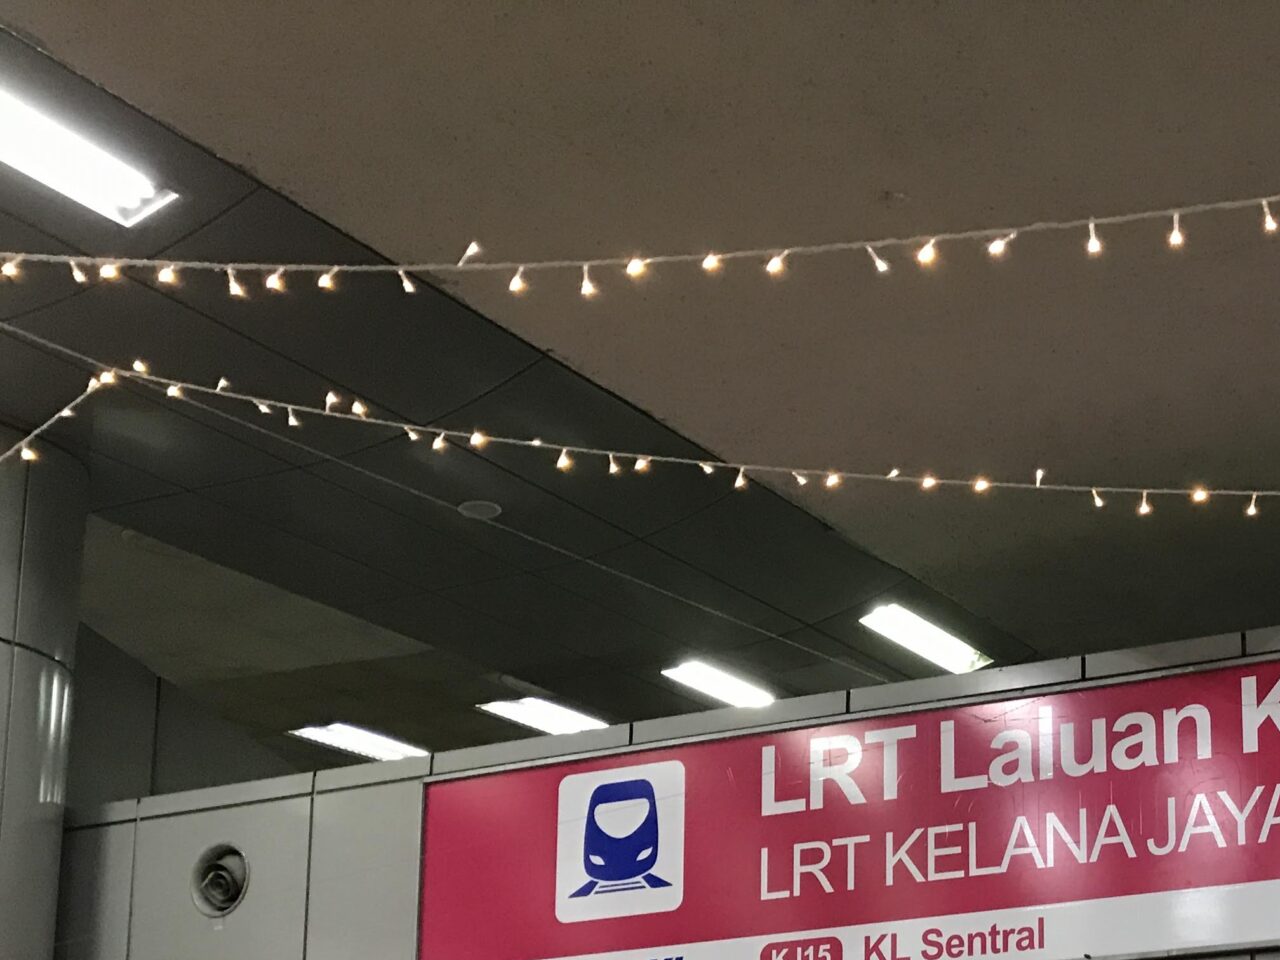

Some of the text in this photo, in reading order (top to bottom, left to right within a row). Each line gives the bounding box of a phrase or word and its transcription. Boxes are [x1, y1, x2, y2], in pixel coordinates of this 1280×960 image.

[760, 725, 917, 817] LRT
[940, 704, 1213, 794] Laluan
[760, 835, 870, 901] LRT
[886, 805, 1135, 888] KELANA
[920, 917, 1045, 959] Sentral
